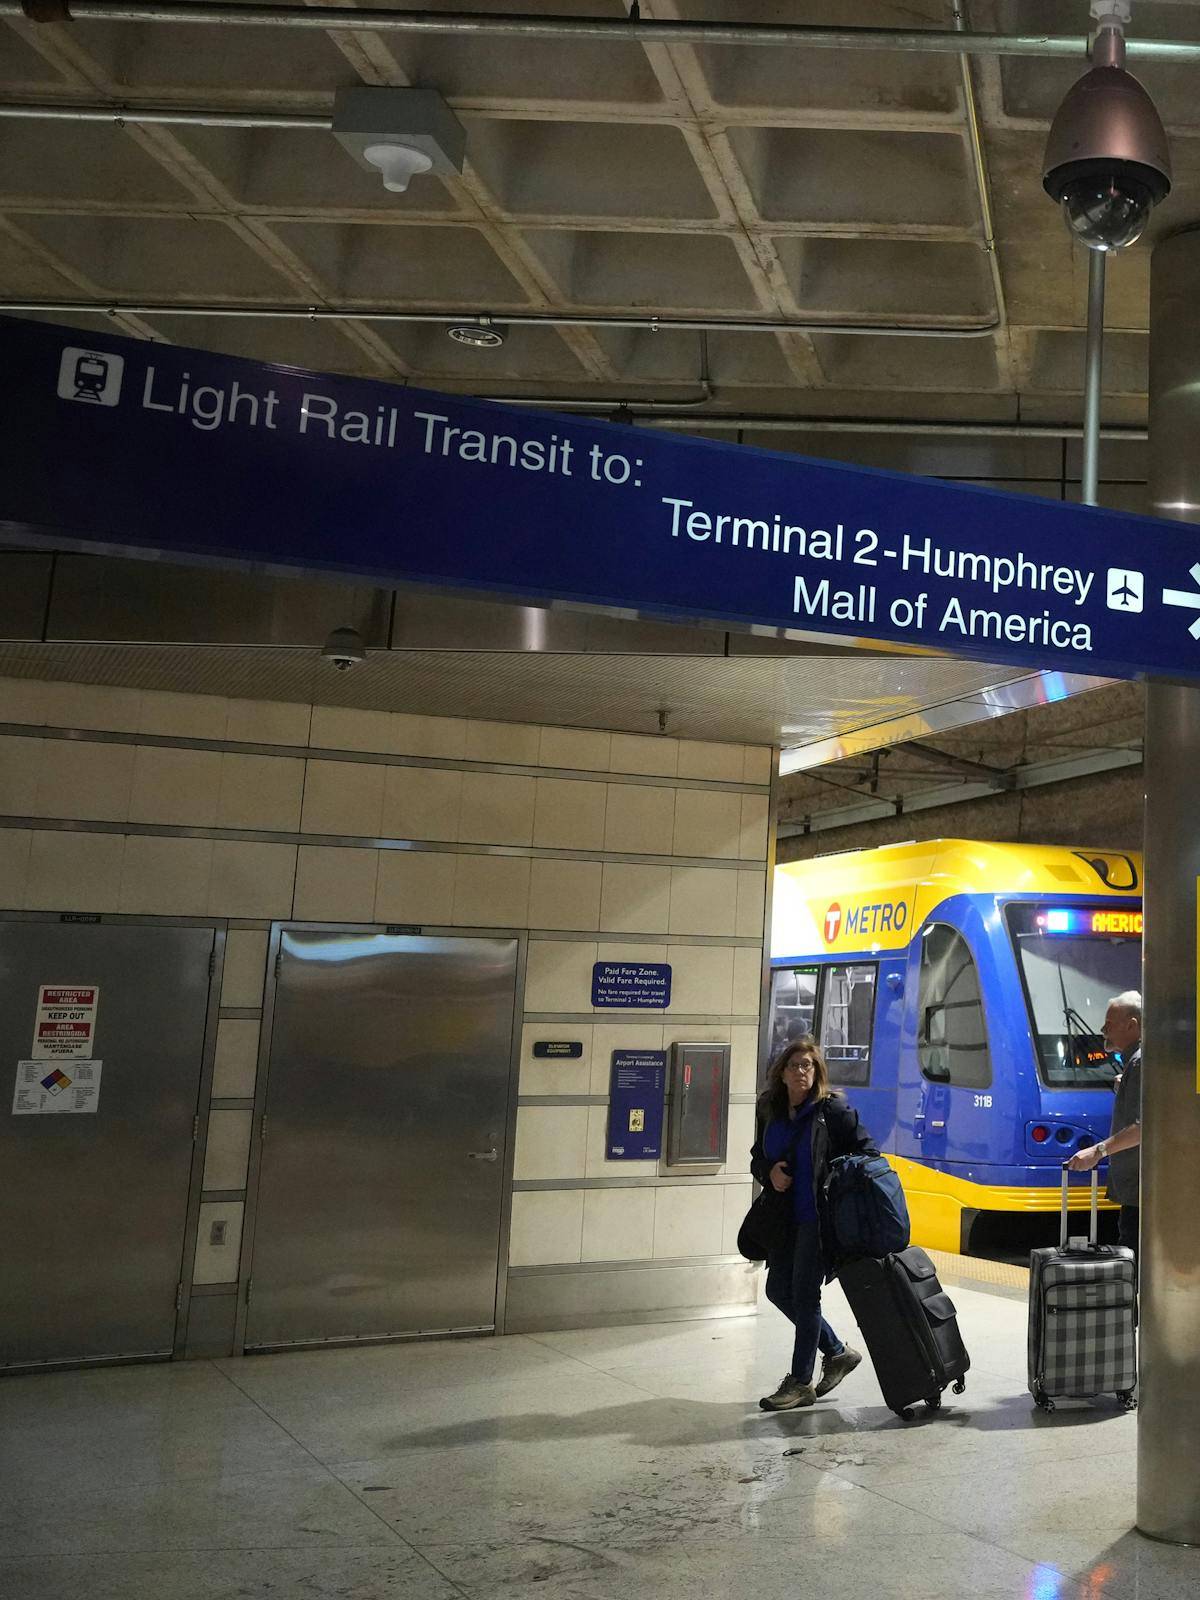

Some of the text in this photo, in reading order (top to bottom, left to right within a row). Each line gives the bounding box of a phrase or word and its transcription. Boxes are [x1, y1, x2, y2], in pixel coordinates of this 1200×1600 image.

[142, 366, 643, 488] Light Rail Transit to:
[661, 497, 844, 561] Terminal
[793, 576, 1093, 651] Mall of America
[845, 901, 907, 935] METRO
[605, 967, 659, 976] Paid Fare Zone.
[598, 976, 615, 984] Valid
[634, 977, 667, 986] Required.
[637, 997, 664, 1005] Humphrey
[48, 1012, 85, 1020] KEEP OUT
[973, 1094, 993, 1108] 311B
